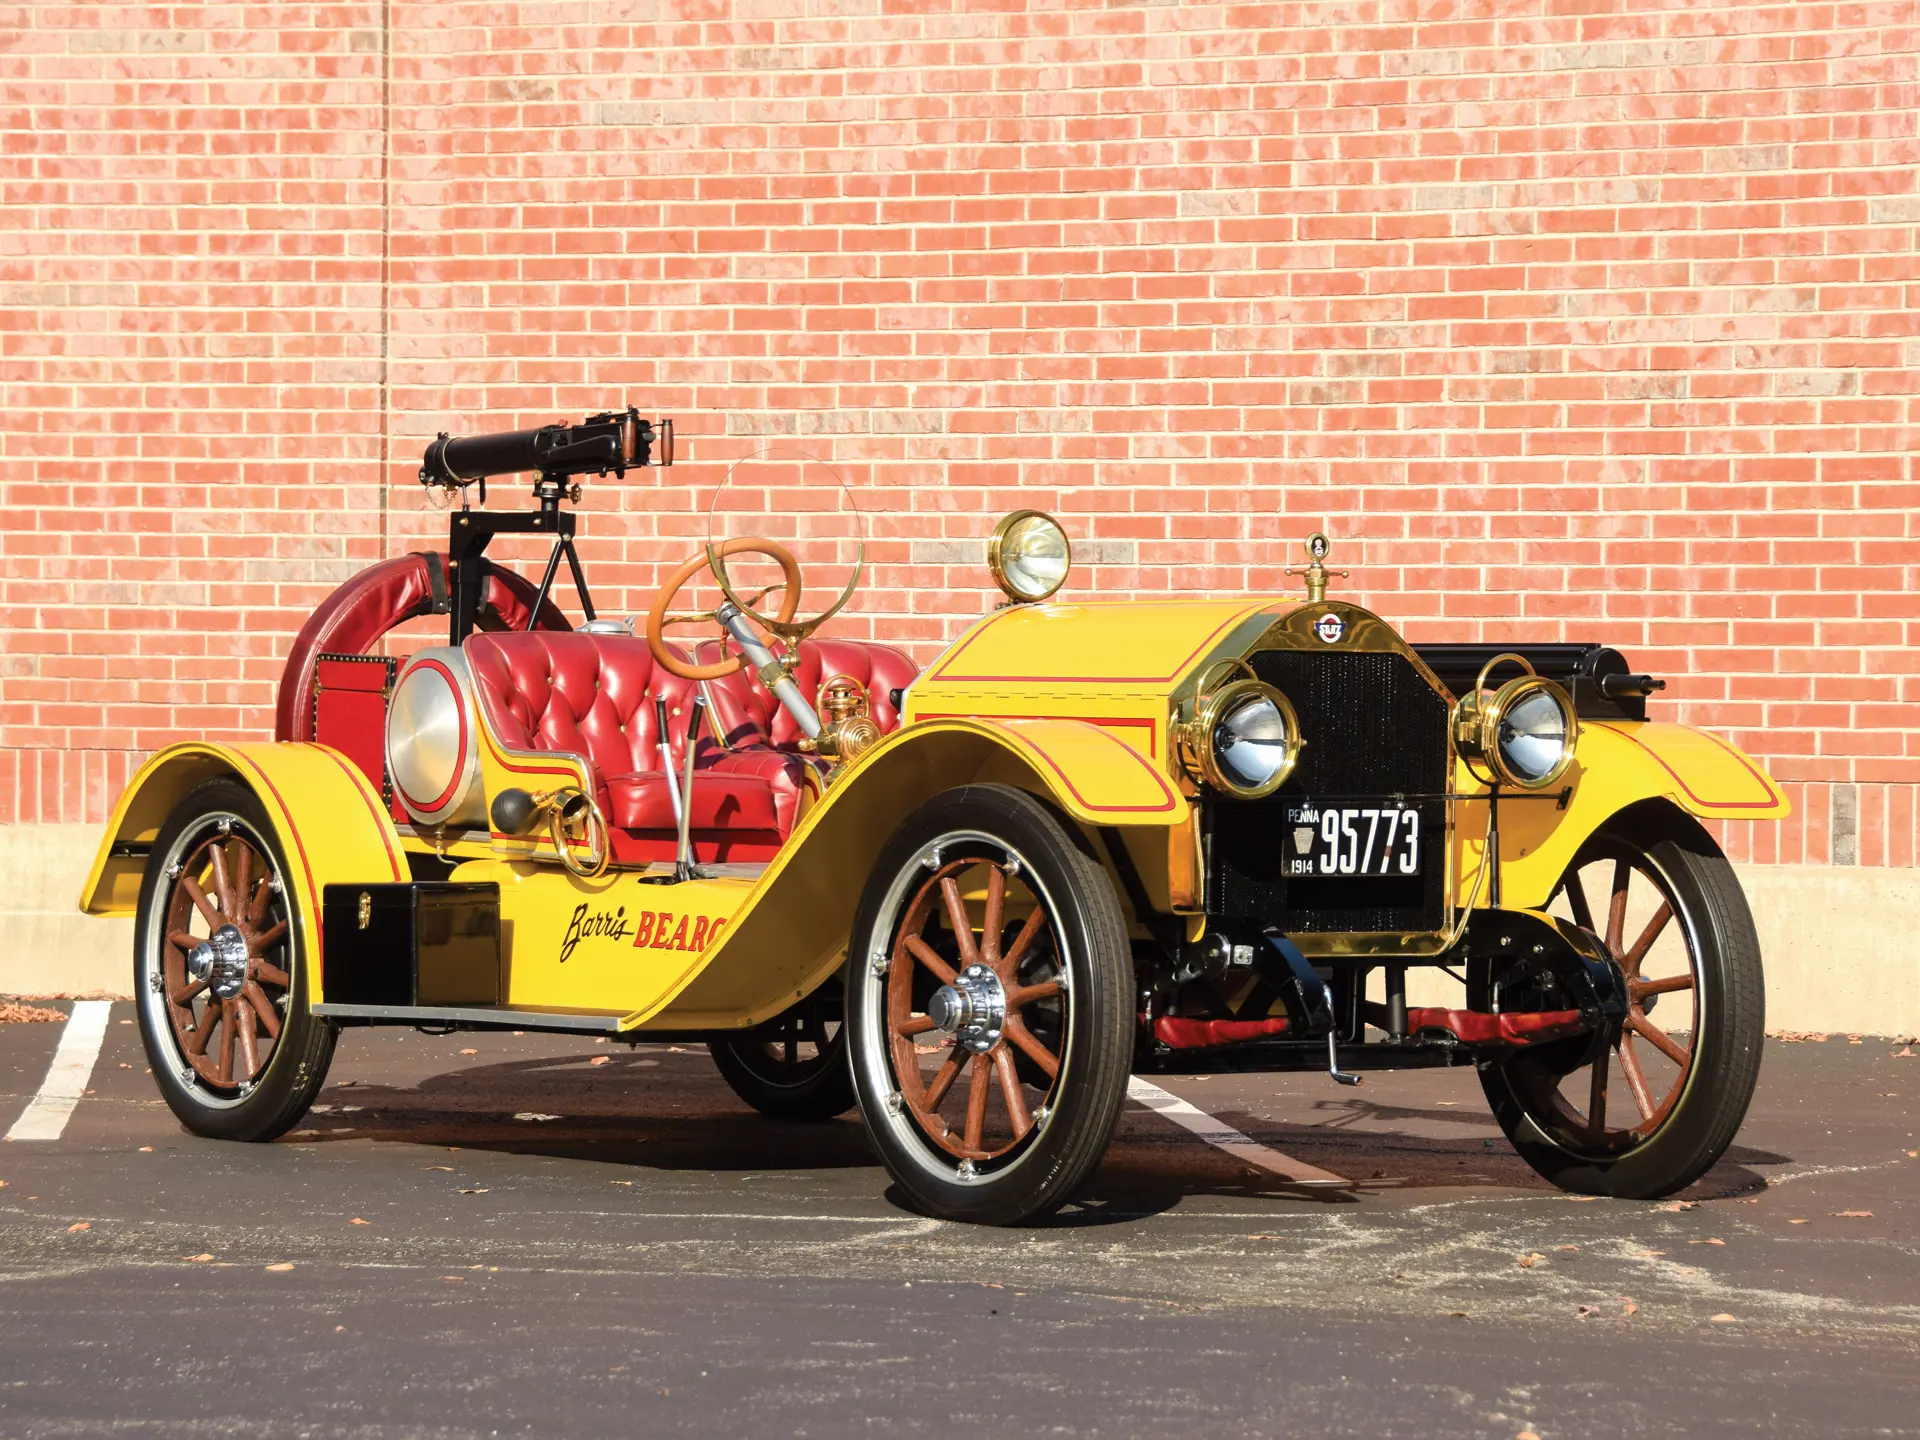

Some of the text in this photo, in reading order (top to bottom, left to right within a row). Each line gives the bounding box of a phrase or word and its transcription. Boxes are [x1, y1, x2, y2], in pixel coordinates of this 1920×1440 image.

[1288, 809, 1320, 823] PENNA
[1320, 809, 1419, 874] 95773
[1291, 860, 1314, 874] 1914
[560, 902, 635, 963] Barris
